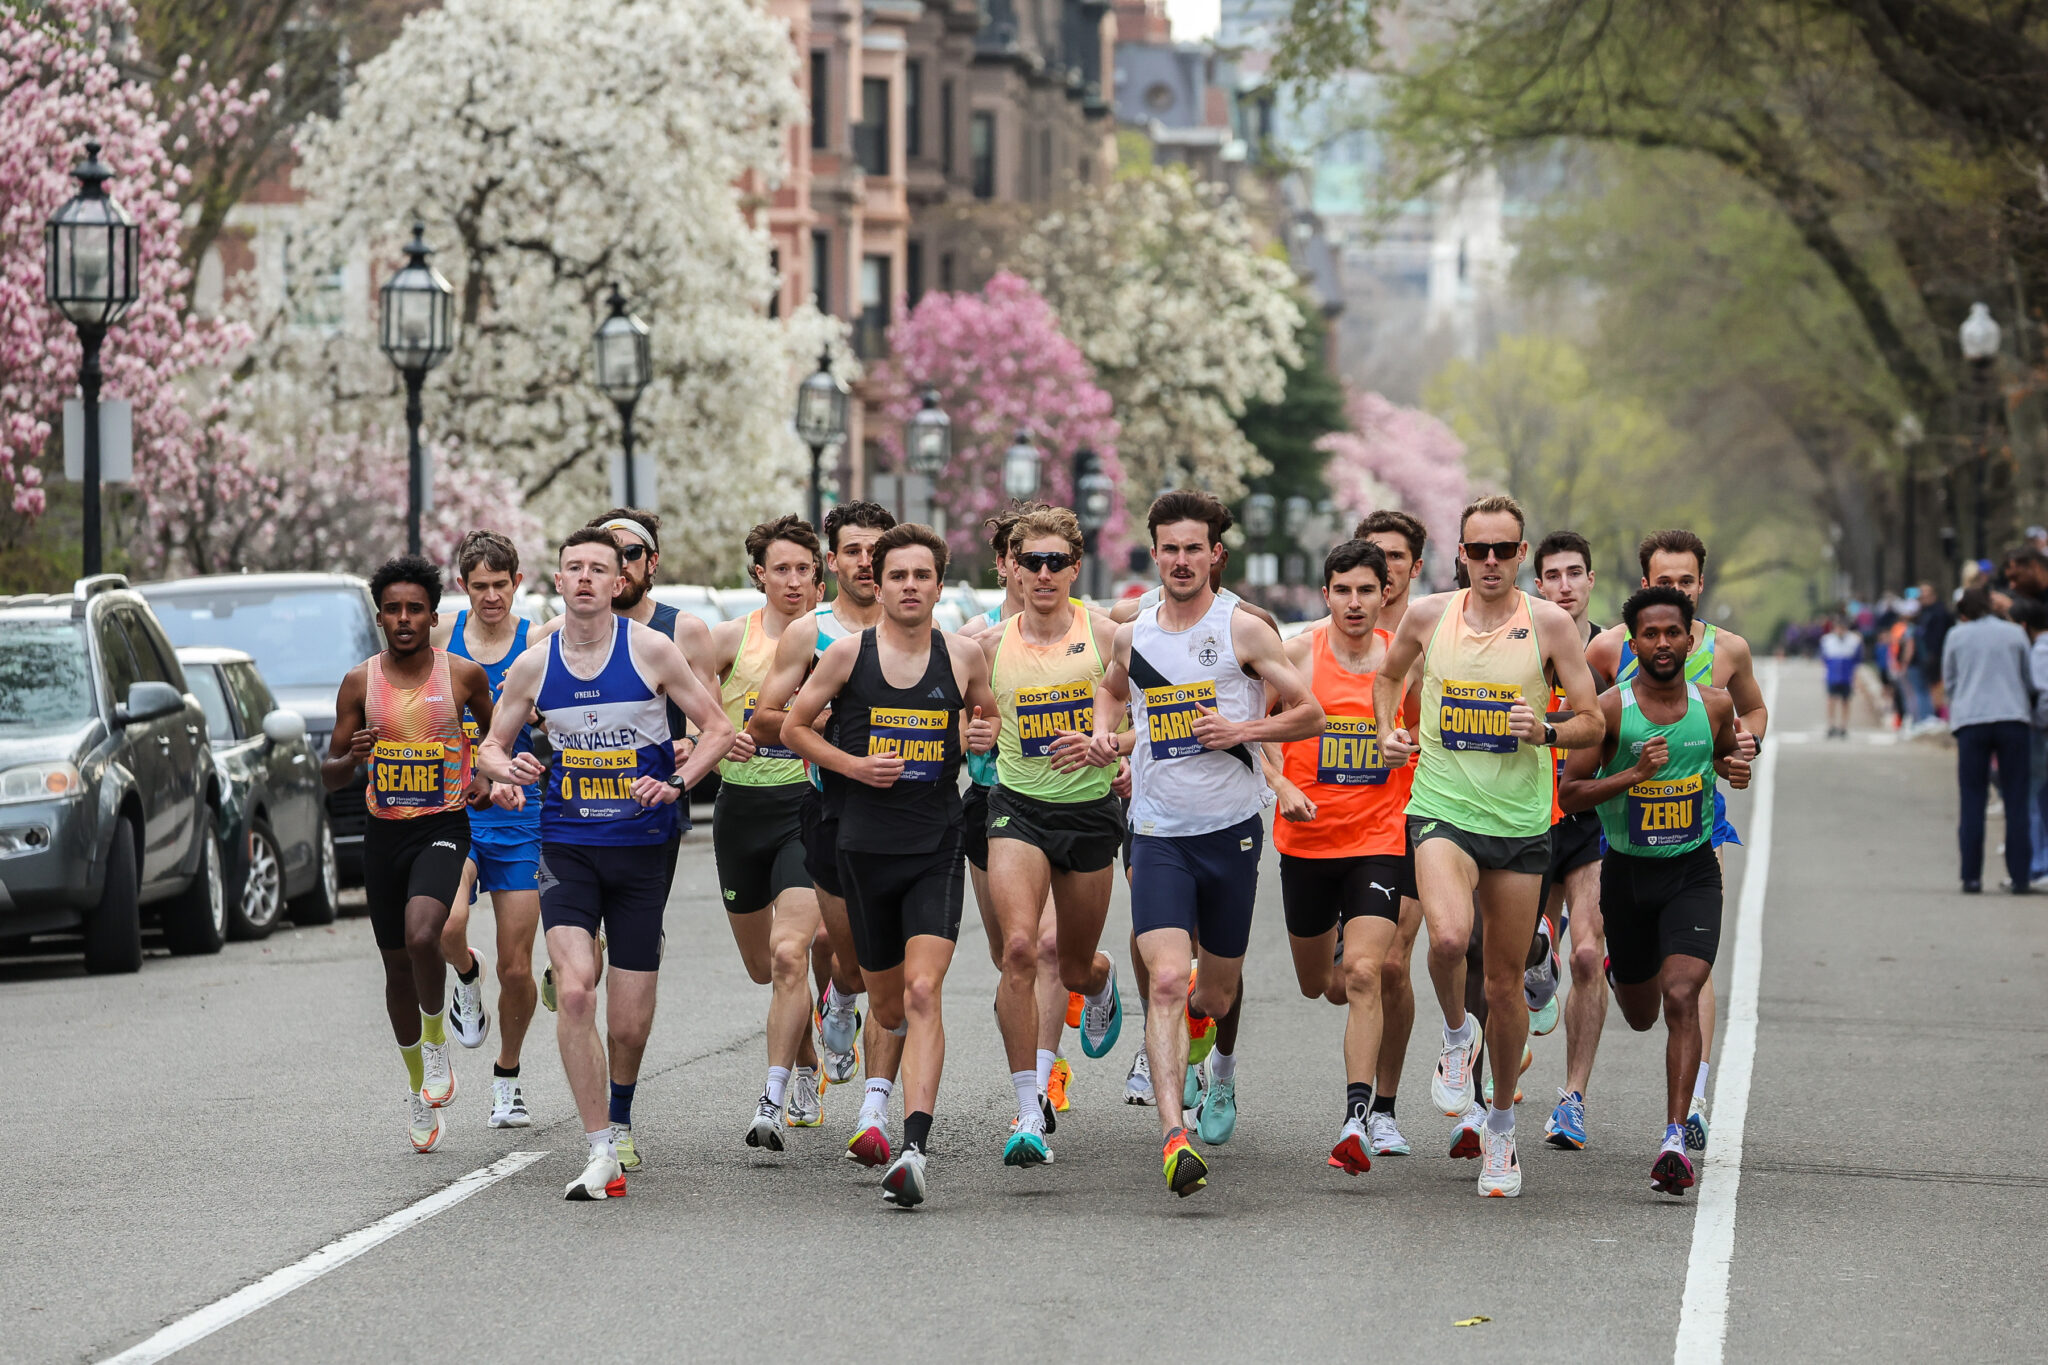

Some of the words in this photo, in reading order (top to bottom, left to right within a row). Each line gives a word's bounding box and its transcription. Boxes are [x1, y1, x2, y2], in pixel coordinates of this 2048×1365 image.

[574, 689, 600, 699] O'NEILLS
[1072, 687, 1087, 698] 5K
[1197, 687, 1212, 698] 5K
[1500, 690, 1517, 699] 5K
[931, 717, 944, 727] 5K
[1018, 707, 1094, 739] CHARLES
[584, 728, 637, 750] VALLEY
[425, 748, 440, 758] 5K
[867, 735, 945, 762] MCLUCKIE
[1321, 736, 1384, 769] DEVE
[616, 756, 632, 765] 5K
[376, 762, 439, 792] SEARE
[561, 771, 573, 800] Ó
[1686, 781, 1698, 792] 5K
[1640, 799, 1693, 831] ZERU
[432, 840, 457, 850] HOKA
